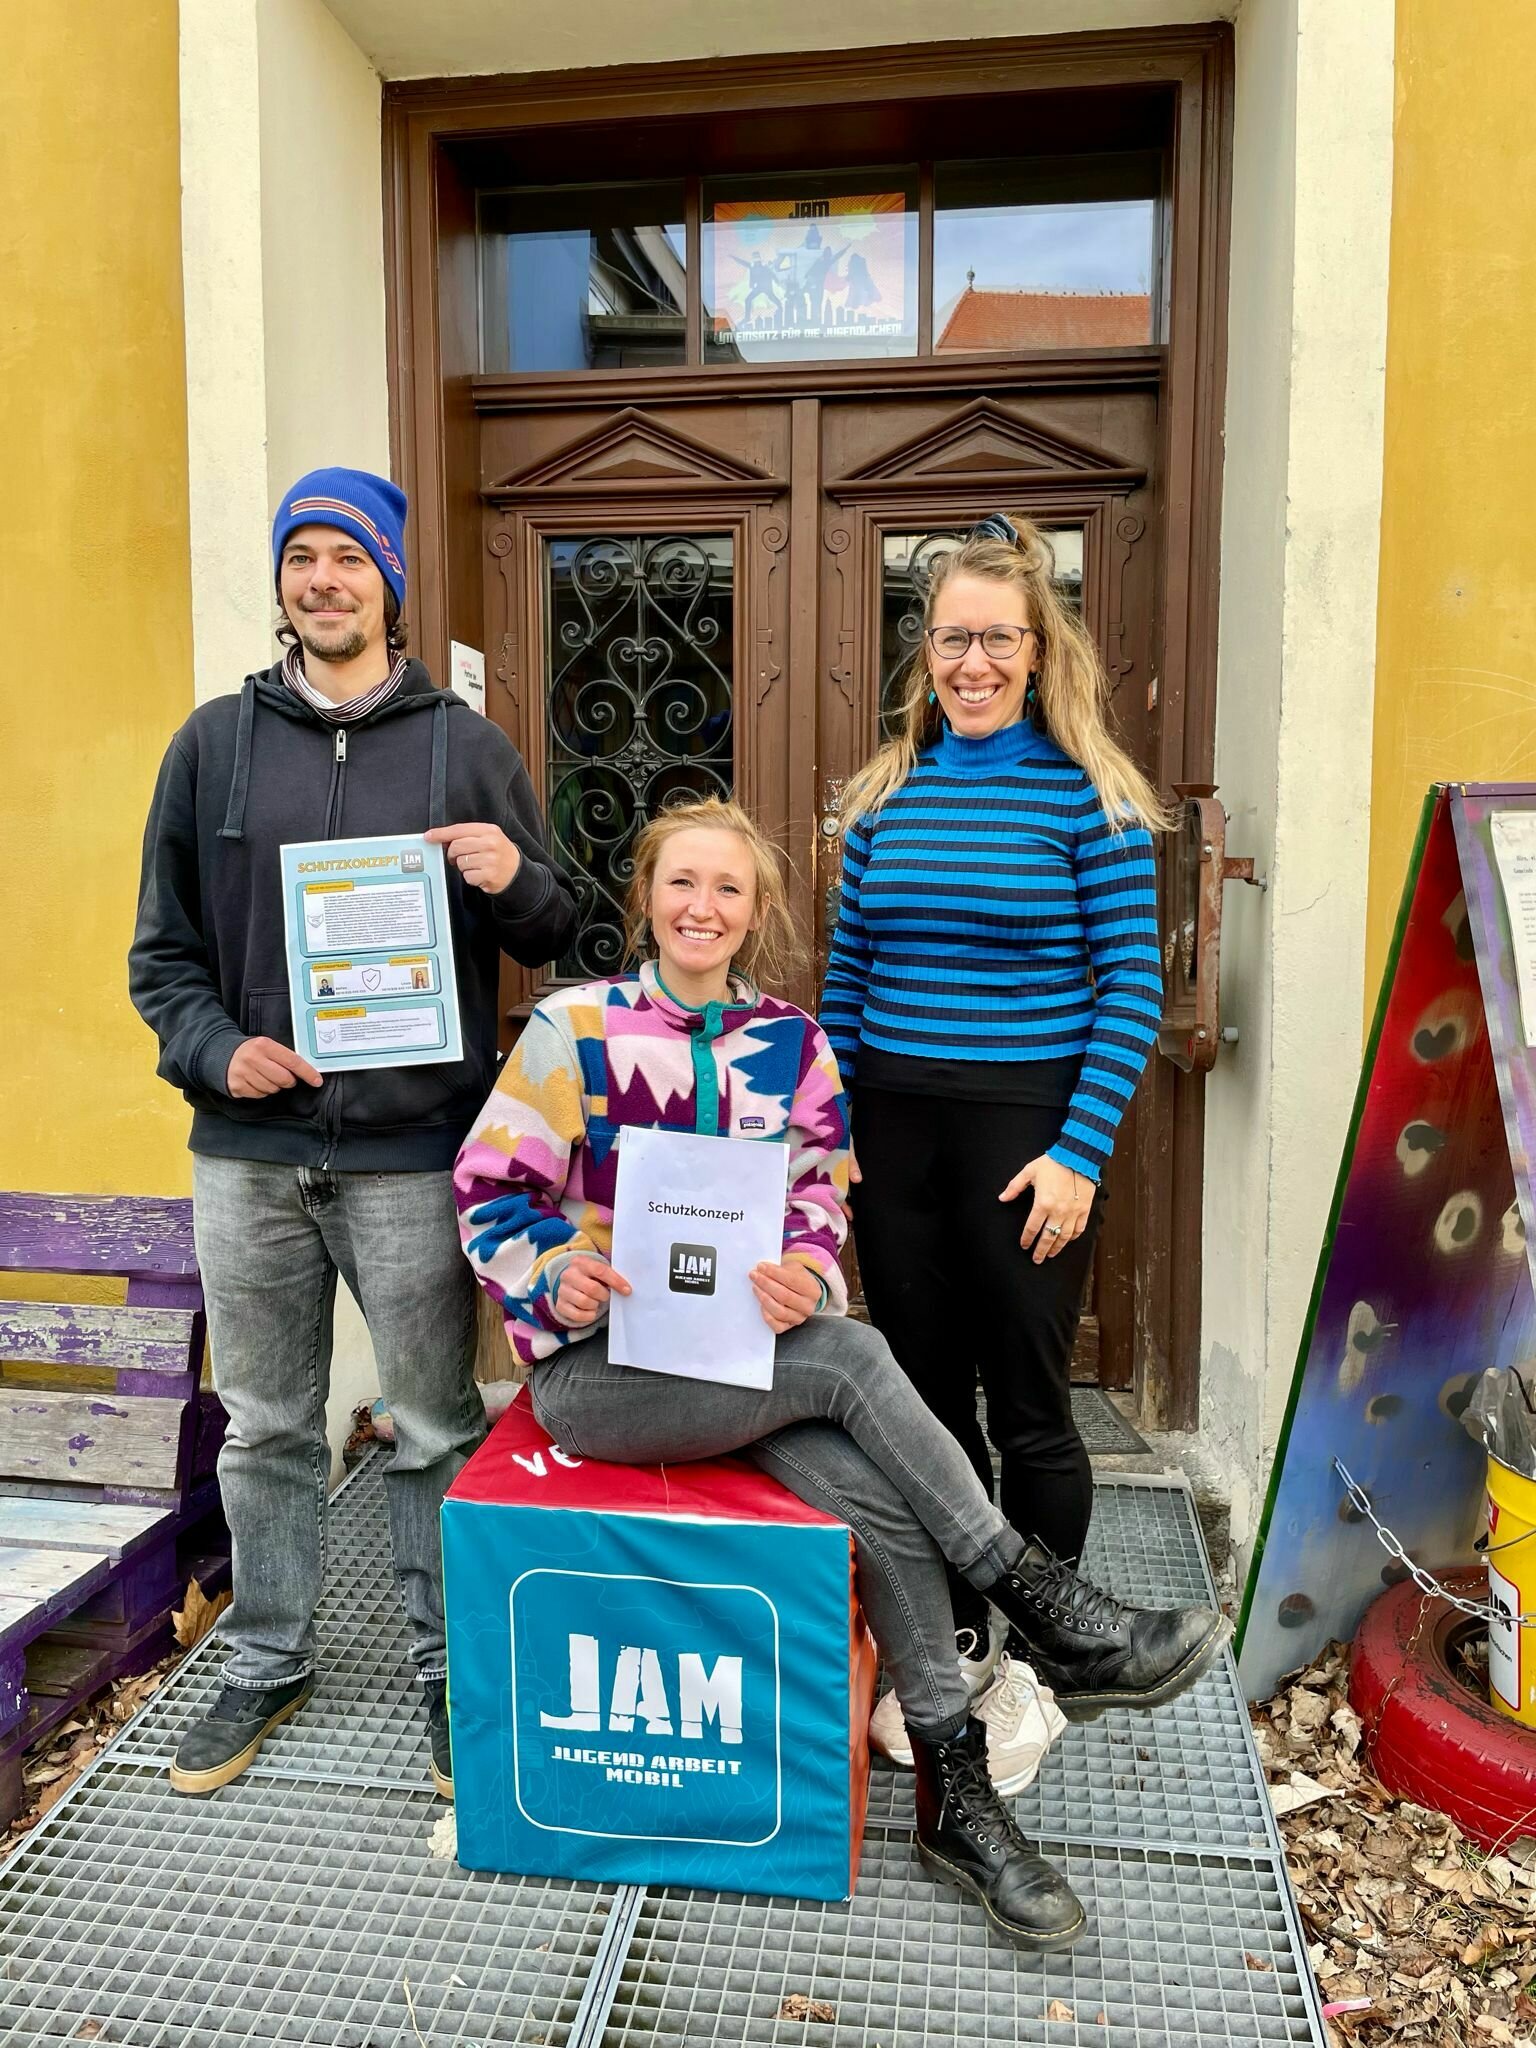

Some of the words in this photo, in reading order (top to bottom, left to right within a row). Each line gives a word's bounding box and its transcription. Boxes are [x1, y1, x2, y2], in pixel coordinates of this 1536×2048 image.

[789, 200, 830, 219] JAM
[735, 330, 778, 342] EINSATZ
[781, 328, 799, 340] FÜR
[803, 327, 820, 339] DIE
[297, 855, 399, 874] SCHUTZKONZEPT
[402, 854, 422, 865] JAM
[648, 1201, 745, 1223] Schutzkonzept
[673, 1253, 712, 1276] JAM
[539, 1632, 744, 1744] JAM
[551, 1745, 645, 1768] JUGEND
[650, 1754, 742, 1775] ARBEIT
[605, 1767, 684, 1788] MOBIL
